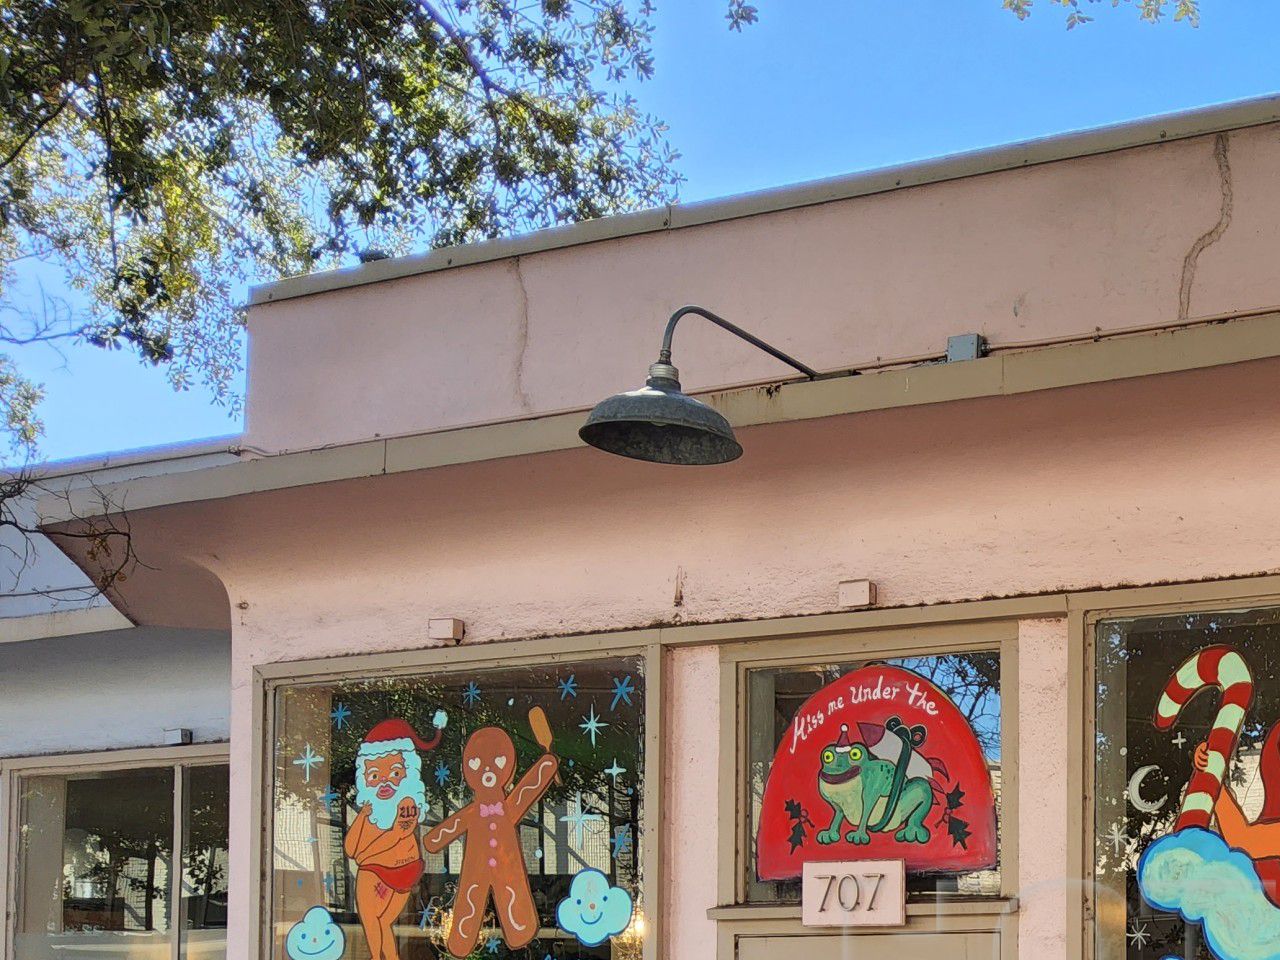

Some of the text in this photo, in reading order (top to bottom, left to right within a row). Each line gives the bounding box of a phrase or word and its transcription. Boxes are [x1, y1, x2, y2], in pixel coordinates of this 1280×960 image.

[828, 696, 845, 716] me
[850, 674, 901, 704] Under
[813, 873, 886, 913] 707
